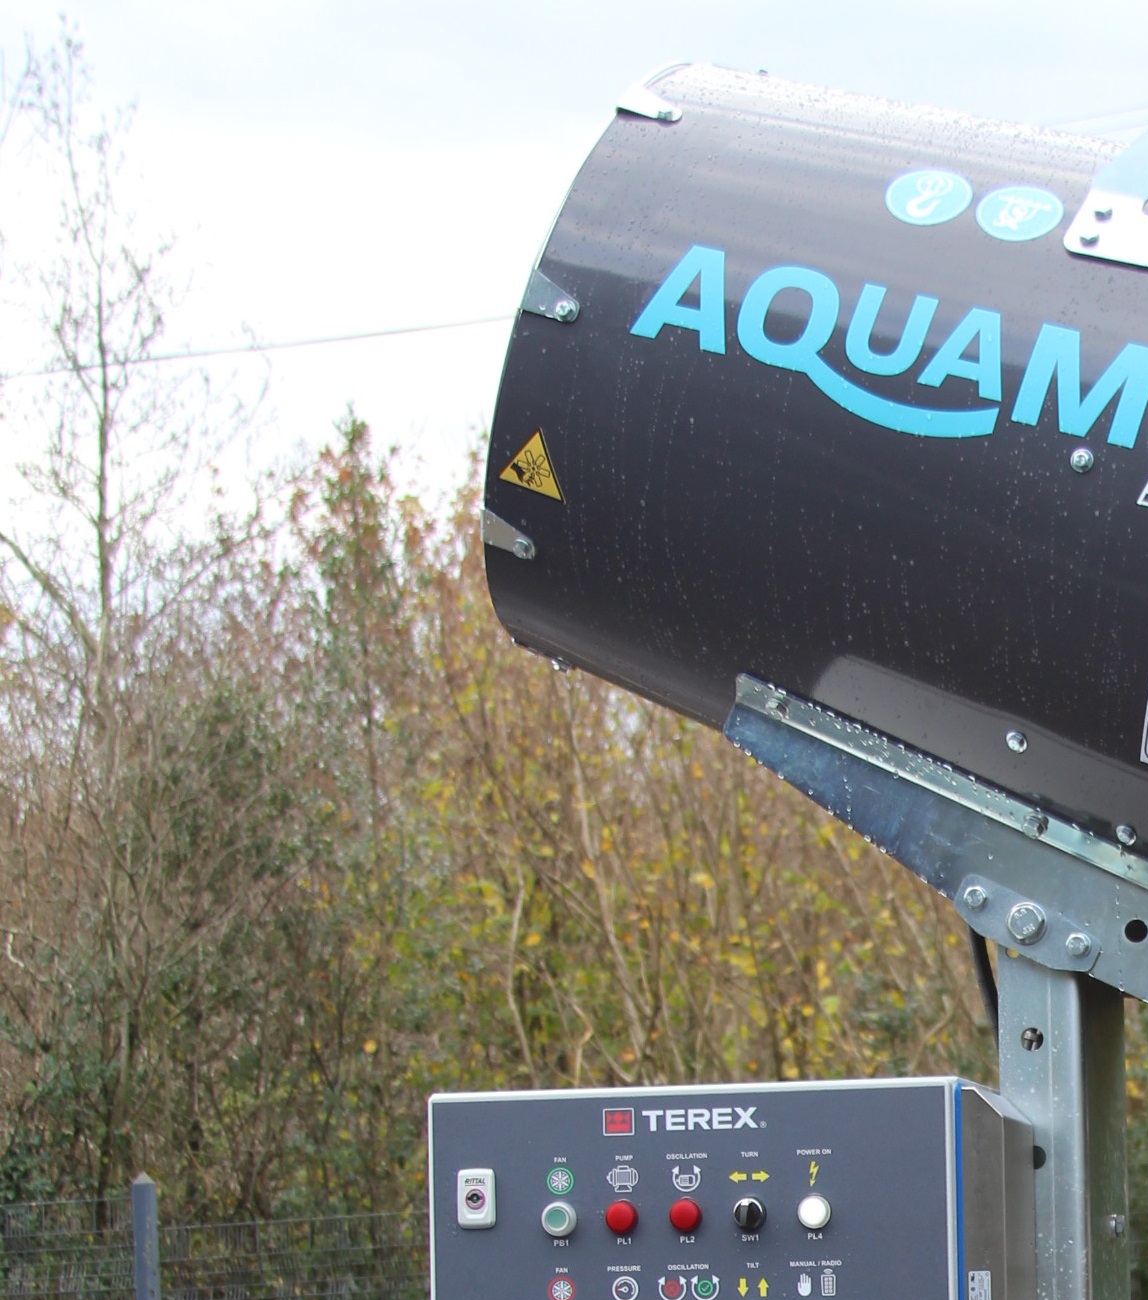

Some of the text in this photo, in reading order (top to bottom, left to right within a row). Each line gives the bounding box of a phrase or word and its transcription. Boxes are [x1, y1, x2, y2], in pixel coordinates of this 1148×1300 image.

[615, 1154, 633, 1162] PUMP
[666, 1152, 708, 1160] OSCILLATION
[464, 1177, 486, 1185] RITTAL
[680, 1236, 695, 1244] PL2
[741, 1234, 759, 1242] SW1
[807, 1232, 823, 1241] PL4
[553, 1239, 569, 1247] PB1
